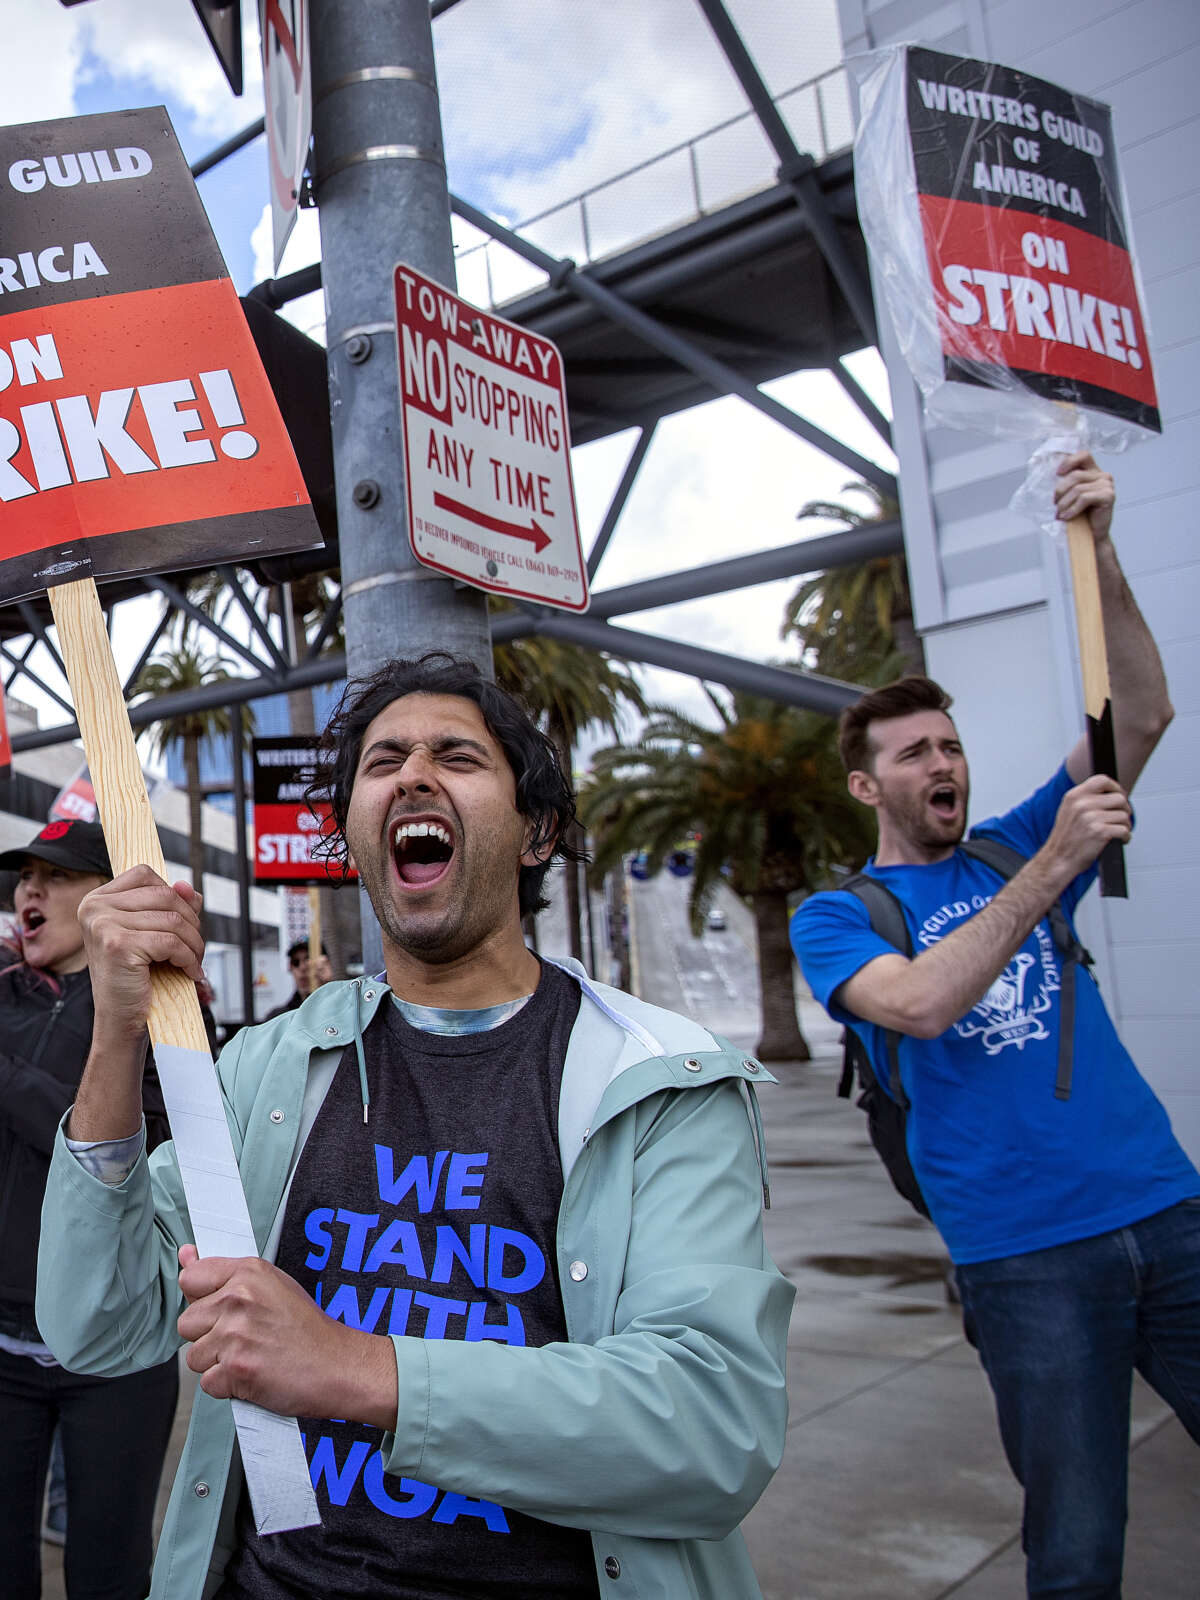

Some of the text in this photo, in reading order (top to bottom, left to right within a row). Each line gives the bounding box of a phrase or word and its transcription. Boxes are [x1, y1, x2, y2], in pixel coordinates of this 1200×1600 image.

[917, 79, 1104, 157] WRITERS GUILD
[1013, 136, 1040, 163] OF
[8, 146, 153, 193] GUILD
[973, 162, 1087, 218] AMERICA
[1022, 231, 1070, 275] ON
[400, 271, 553, 380] TOW-AWAY
[942, 264, 1143, 370] STRIKE!
[402, 324, 560, 453] NO STOPPING
[428, 428, 555, 518] ANY TIME
[507, 553, 524, 568] CALL
[923, 901, 971, 933] GUILD
[1033, 924, 1061, 991] MERICA
[374, 1143, 489, 1214] WE
[304, 1207, 546, 1294] STAND
